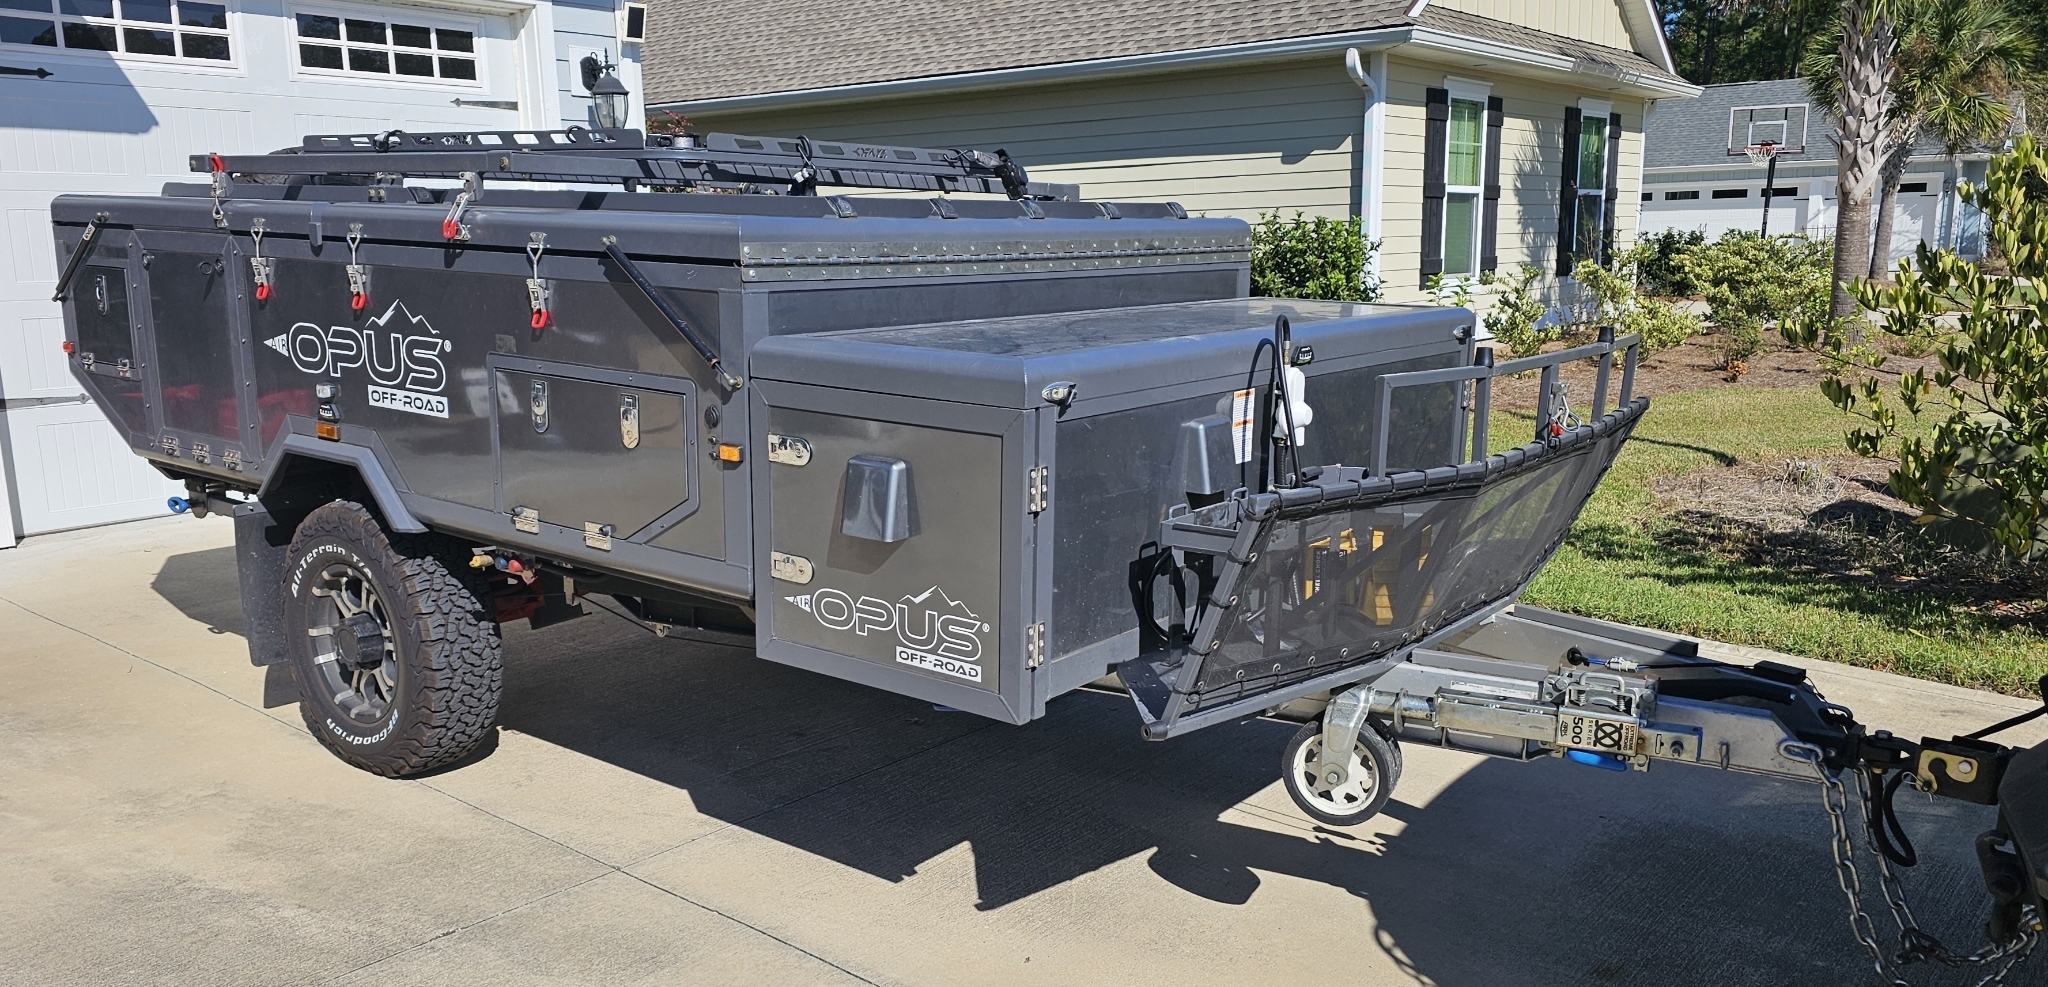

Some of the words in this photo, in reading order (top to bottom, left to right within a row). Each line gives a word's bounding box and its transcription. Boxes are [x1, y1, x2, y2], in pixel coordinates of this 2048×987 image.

[270, 335, 288, 354] AIR
[288, 322, 446, 393] OPUS
[370, 390, 446, 414] OFF-ROAD
[291, 544, 346, 598] All-Terrain
[351, 553, 373, 580] T/A
[793, 595, 811, 609] AIR
[812, 588, 982, 661] OPUS
[898, 650, 979, 678] OFF-ROAD
[326, 708, 399, 745] BFGoodrich
[1572, 717, 1583, 744] 500
